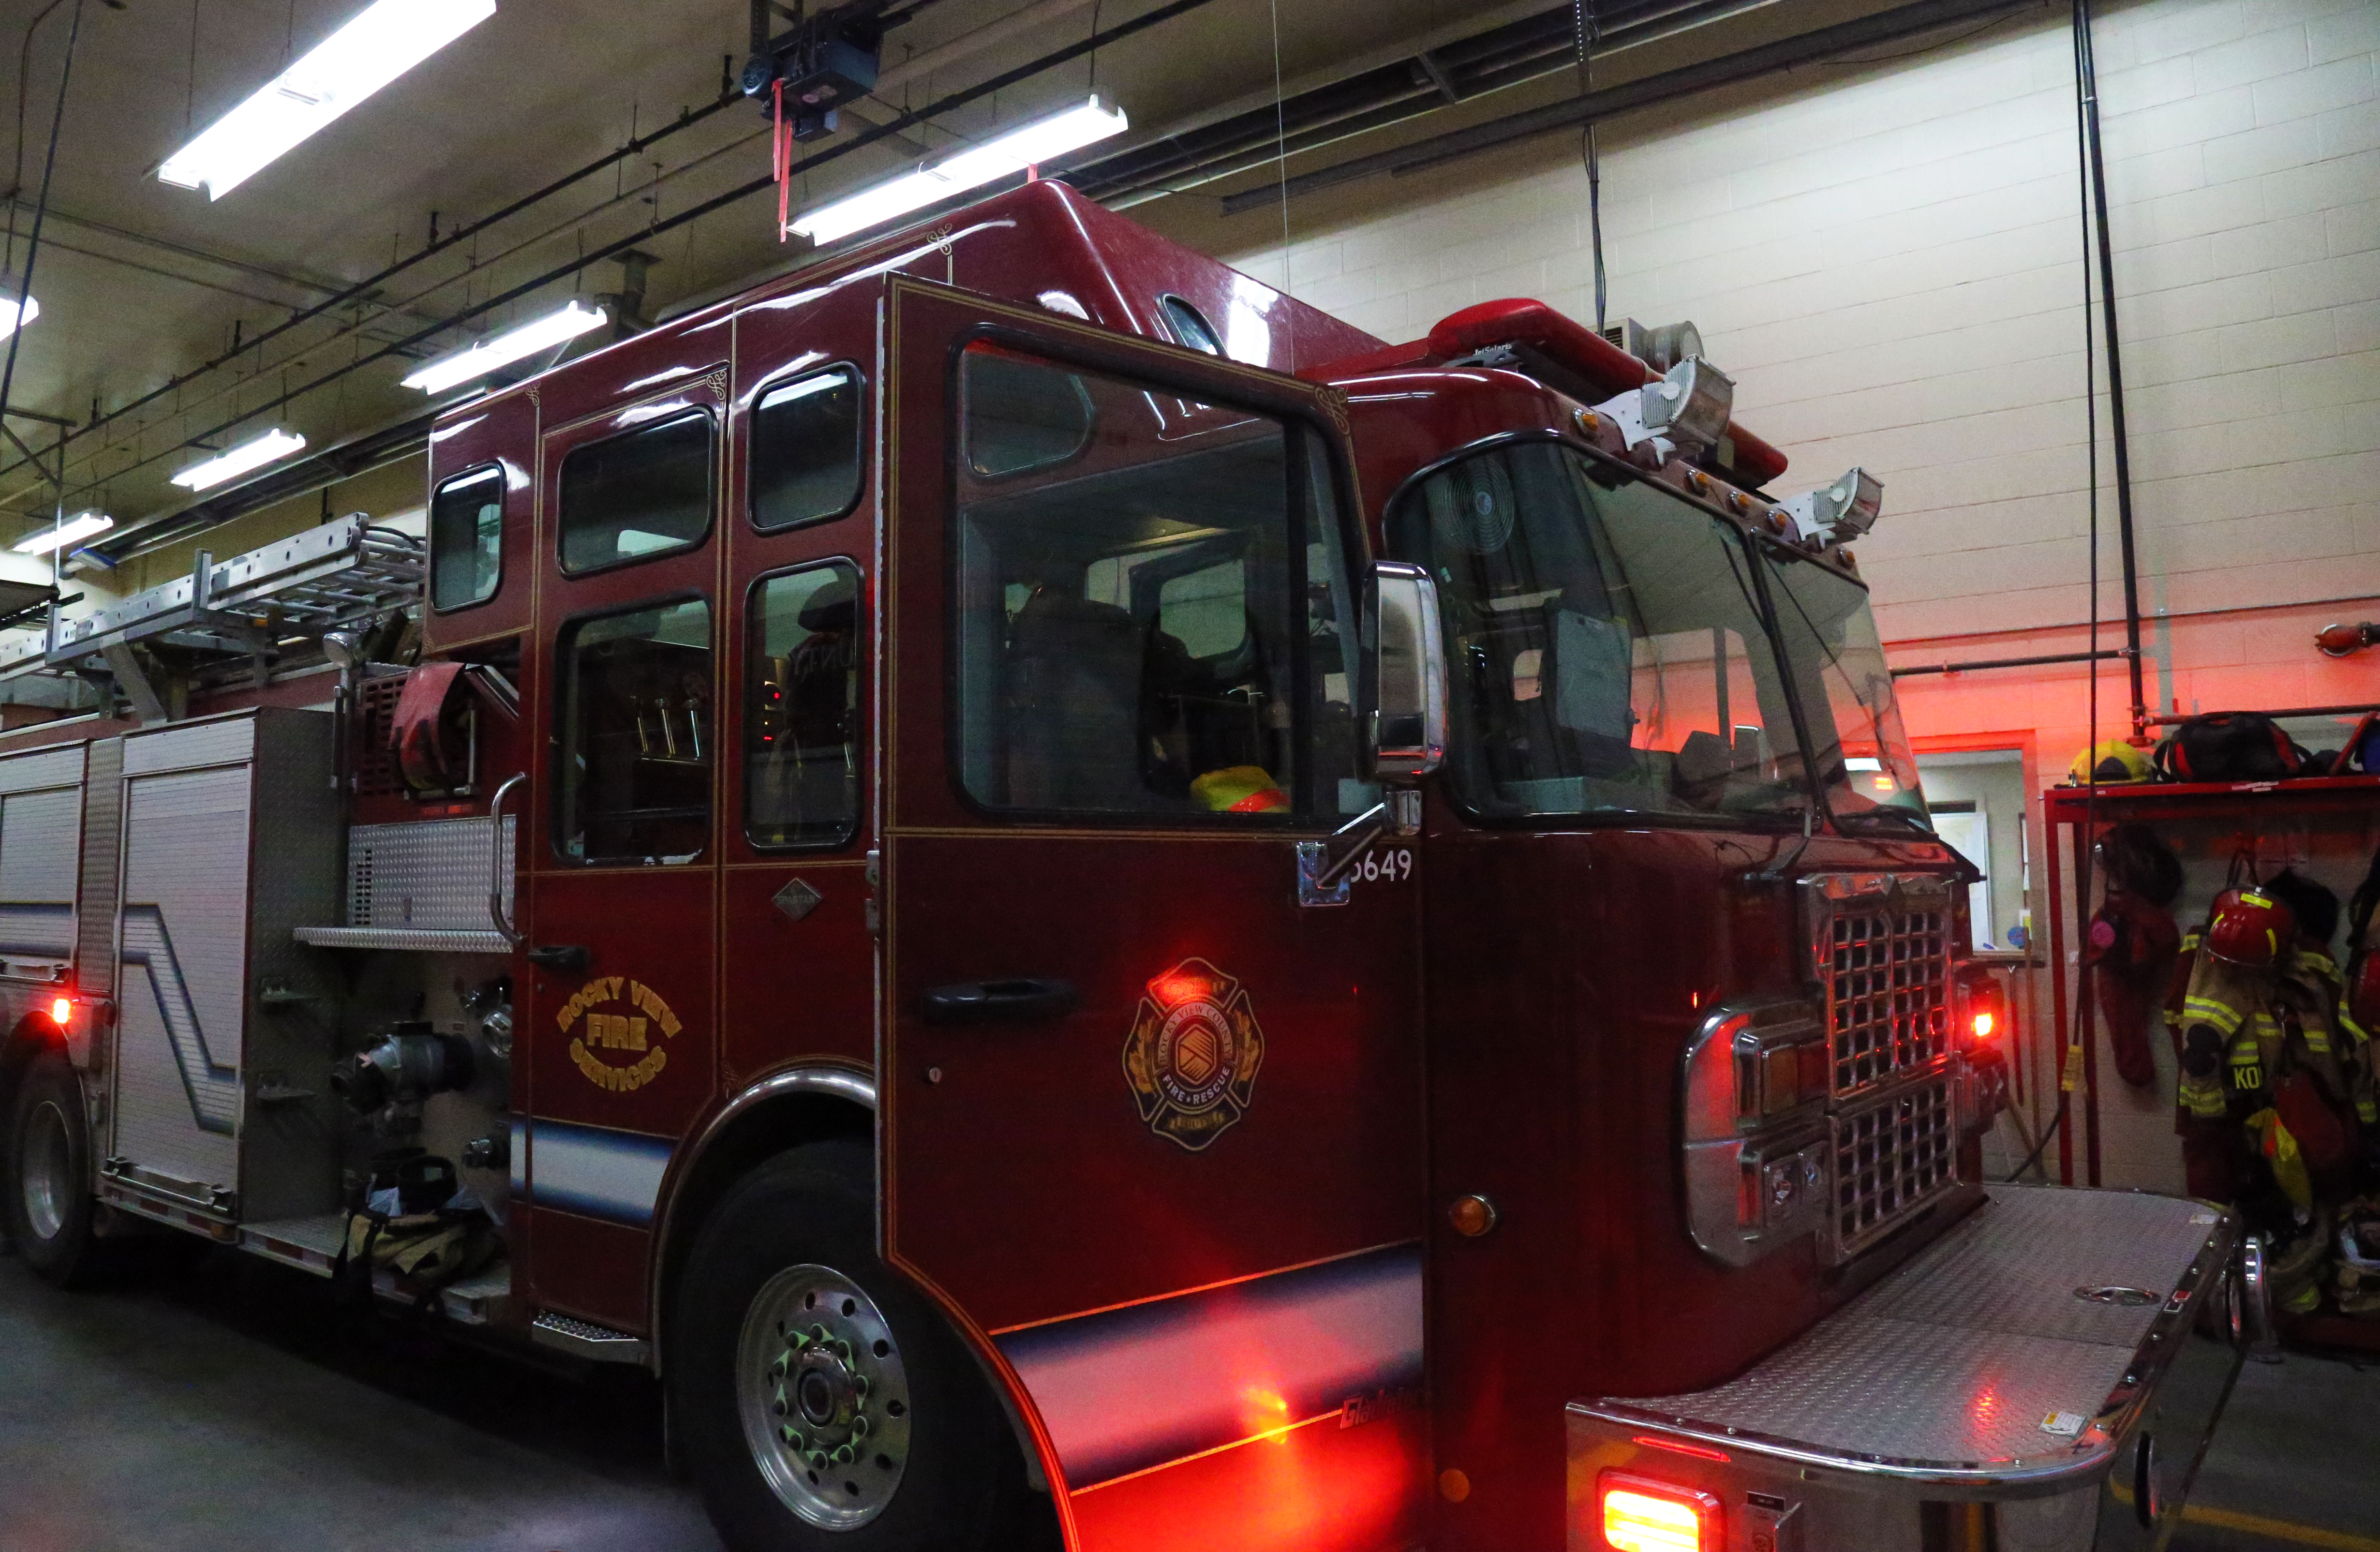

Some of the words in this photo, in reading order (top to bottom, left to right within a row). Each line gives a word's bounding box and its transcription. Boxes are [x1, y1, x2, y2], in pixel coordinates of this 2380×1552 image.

[776, 894, 816, 905] SPARTAN
[556, 976, 625, 1033] ROCKY
[630, 979, 683, 1039] VIEW
[586, 1013, 648, 1051] FIRE
[1159, 1019, 1177, 1063] ROCKY
[1177, 1004, 1204, 1019] VIEW
[1206, 1007, 1233, 1057] COUNTY
[569, 1037, 667, 1092] SERVICES
[1162, 1074, 1186, 1103] FIRE
[1192, 1066, 1231, 1105] RESCUE
